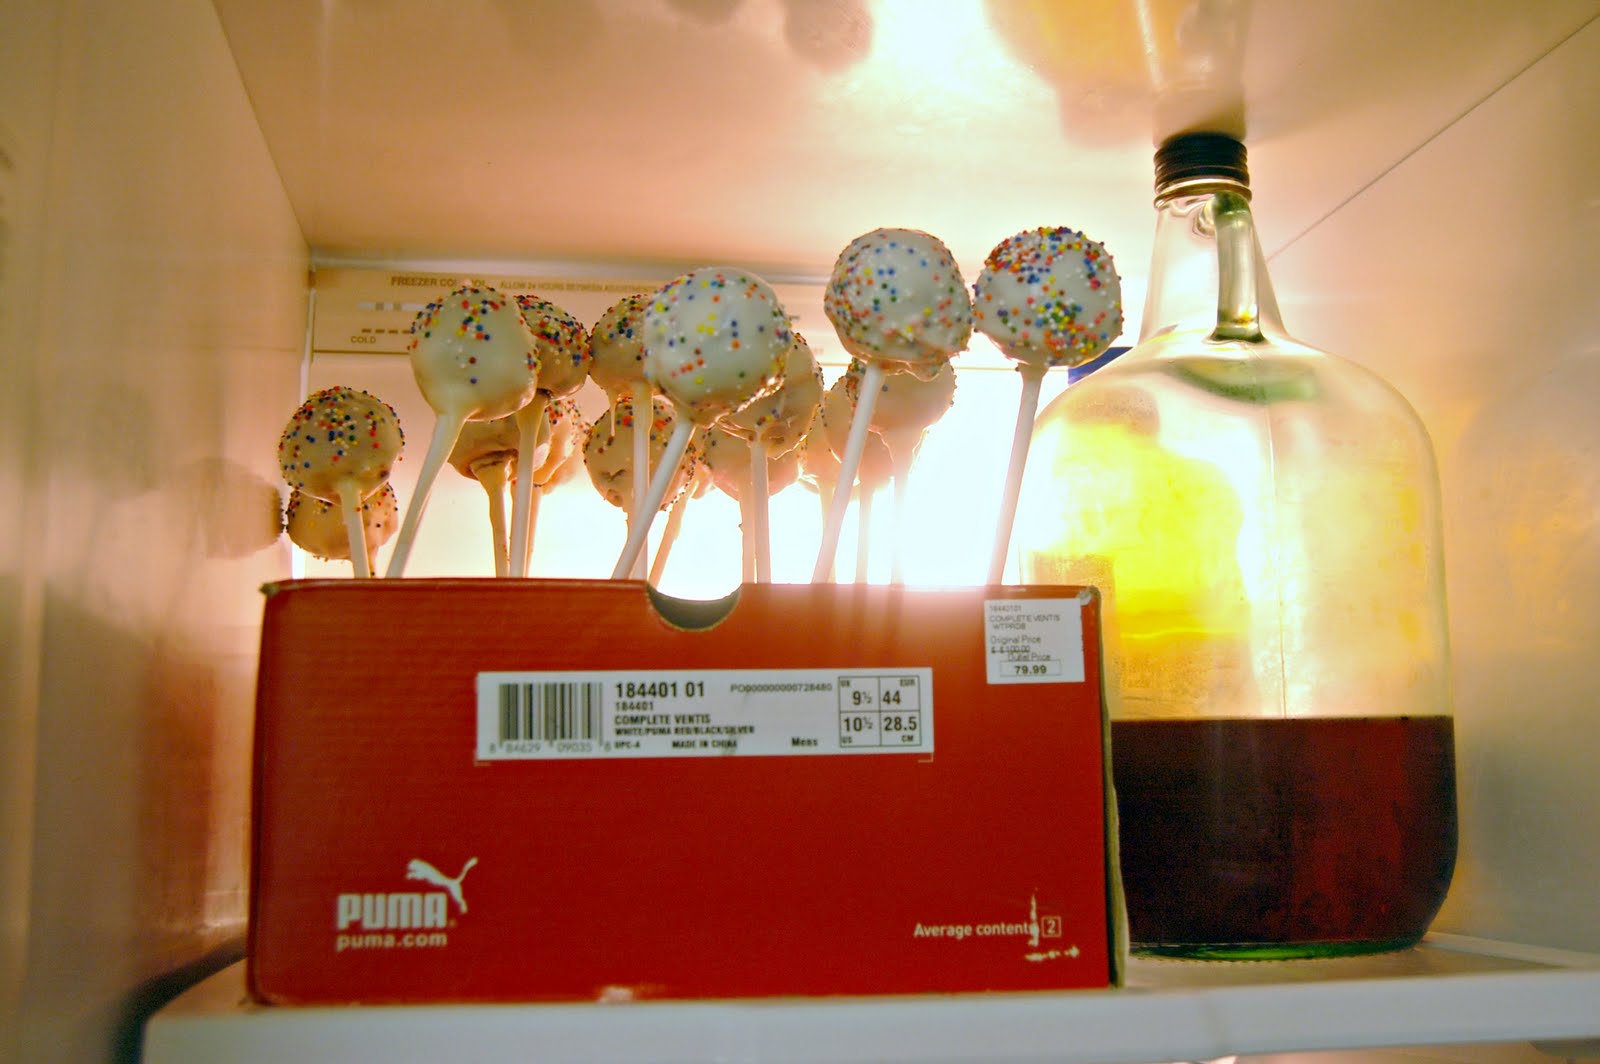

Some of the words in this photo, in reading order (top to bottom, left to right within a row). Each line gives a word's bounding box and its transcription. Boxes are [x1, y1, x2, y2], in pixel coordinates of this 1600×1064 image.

[391, 276, 437, 287] FREEZER
[350, 336, 377, 344] COLD
[990, 635, 1019, 645] Original
[1021, 634, 1041, 643] Price
[1014, 665, 1047, 674] 79.99
[615, 682, 678, 698] 184401
[685, 682, 705, 697] 01
[882, 691, 901, 705] 44
[615, 702, 654, 711] 184401
[614, 715, 671, 725] COMPLETE
[674, 714, 711, 724] VENTIS
[883, 716, 918, 732] 28.5
[614, 727, 671, 736] WHITE/PUMA
[791, 737, 818, 747] Mens
[901, 734, 914, 742] CM
[711, 740, 738, 748] CHINA
[337, 892, 448, 930] PUMA
[913, 922, 972, 940] Average
[336, 932, 448, 952] puma.com
